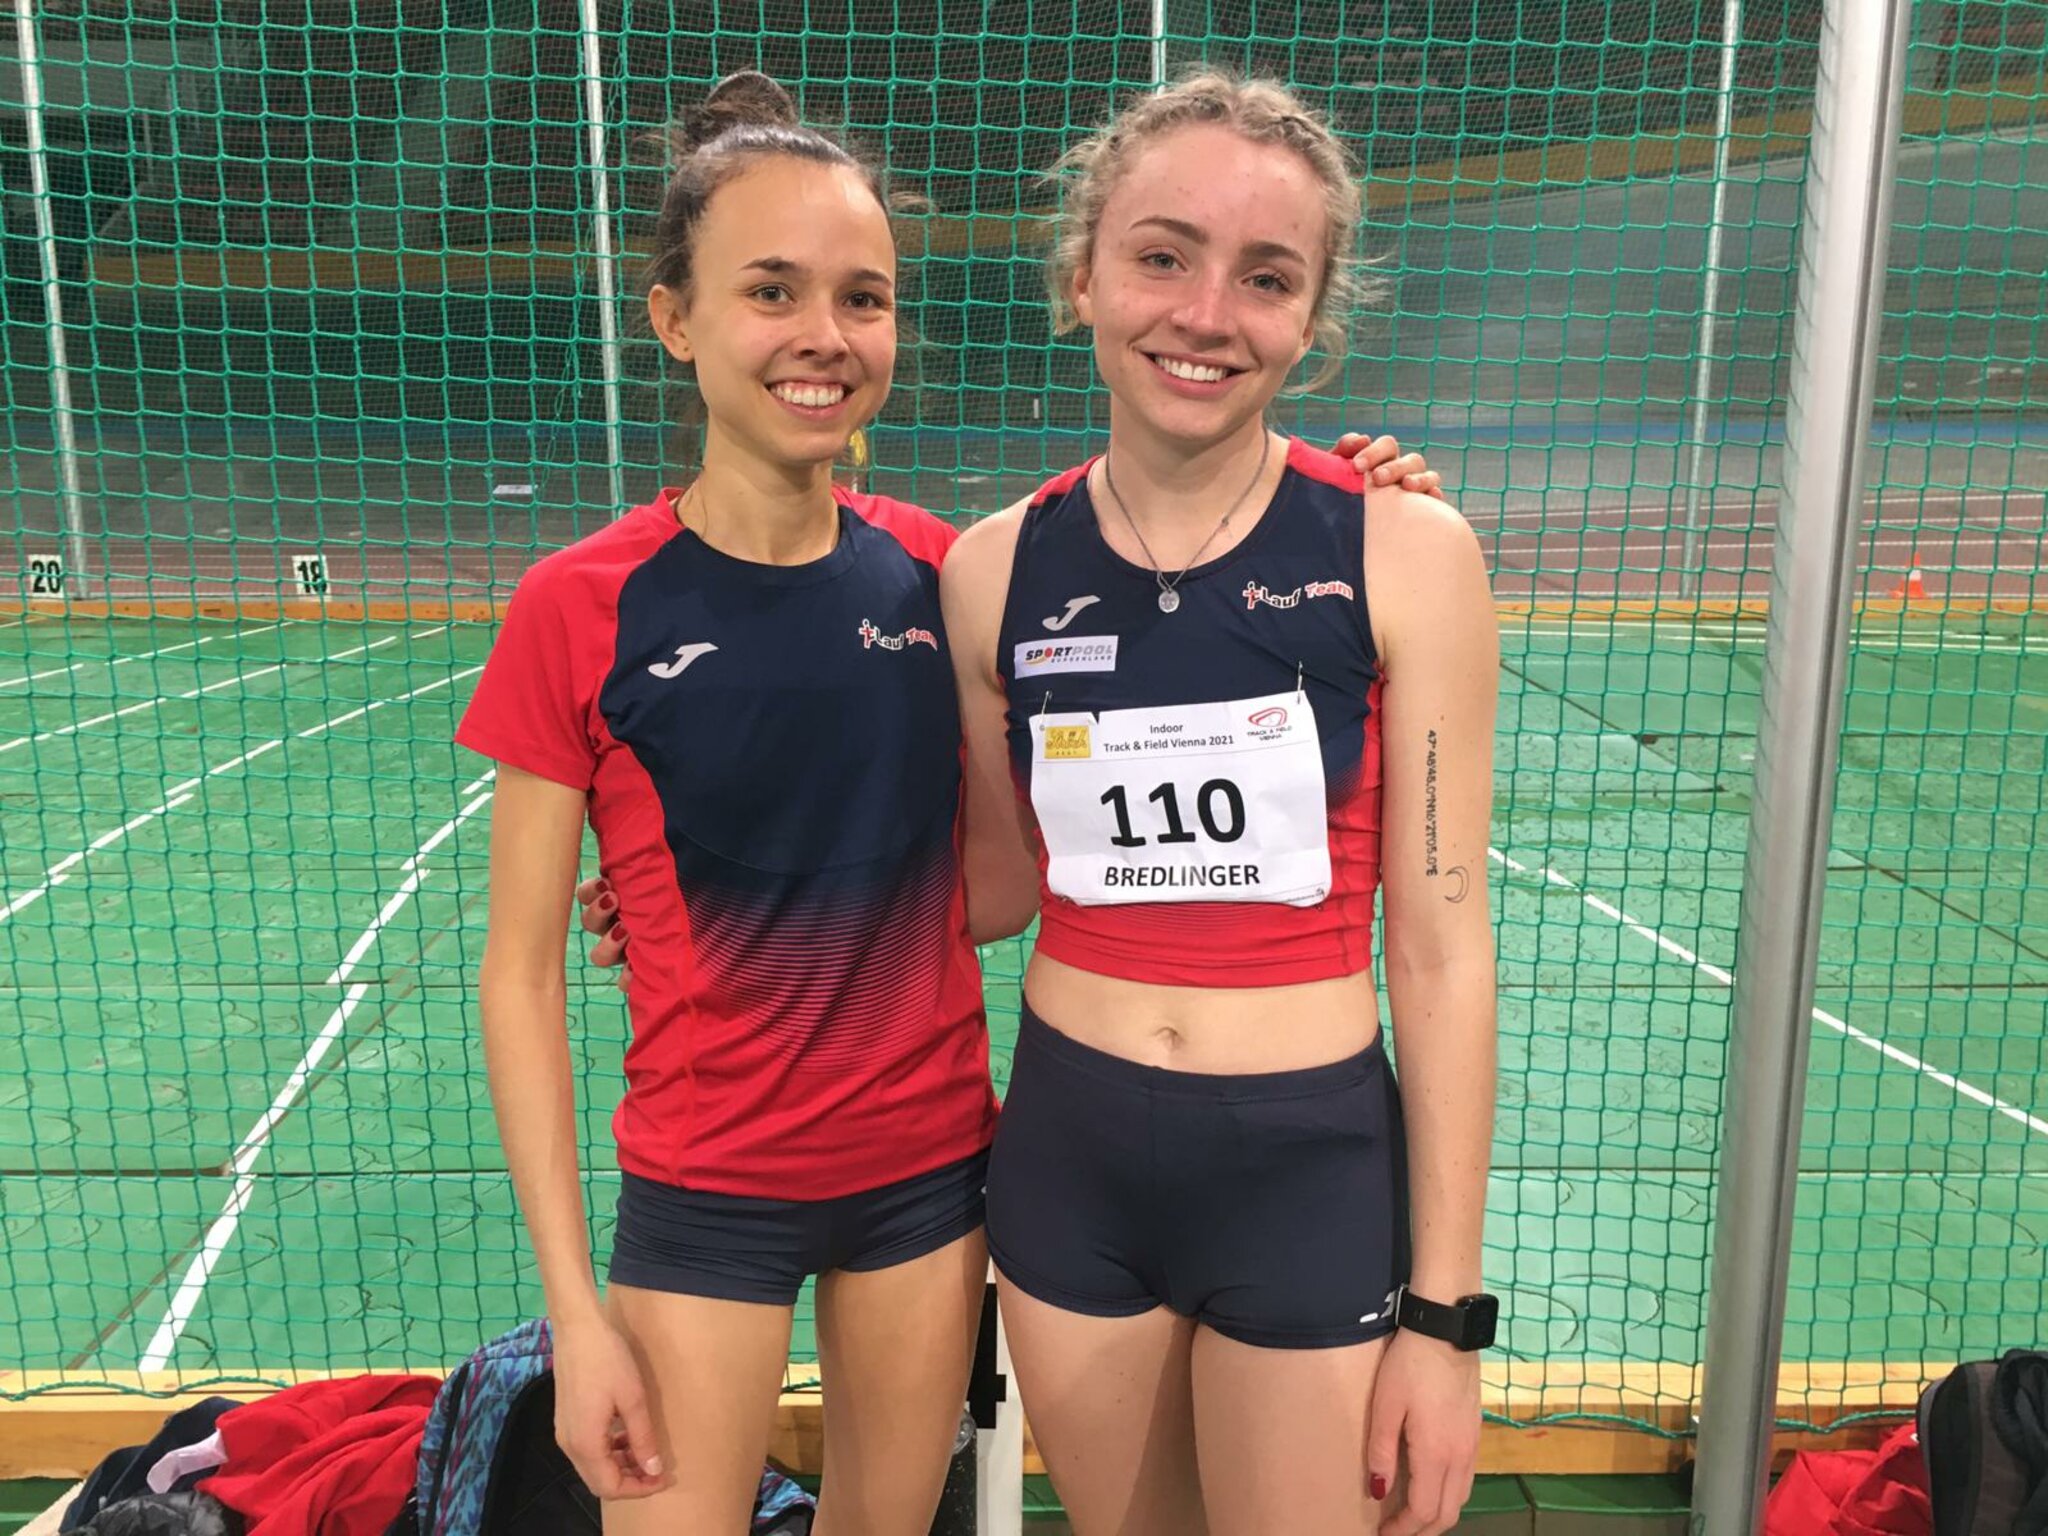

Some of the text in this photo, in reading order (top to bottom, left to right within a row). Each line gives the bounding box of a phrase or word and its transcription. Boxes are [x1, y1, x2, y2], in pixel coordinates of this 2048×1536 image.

[32, 560, 61, 594] 20
[1260, 580, 1354, 609] Lauf Team
[1150, 724, 1183, 734] Indoor
[1104, 735, 1234, 752] Track & Field Vienna 2021
[1100, 778, 1246, 847] 110
[1104, 865, 1260, 887] BREDLINGER
